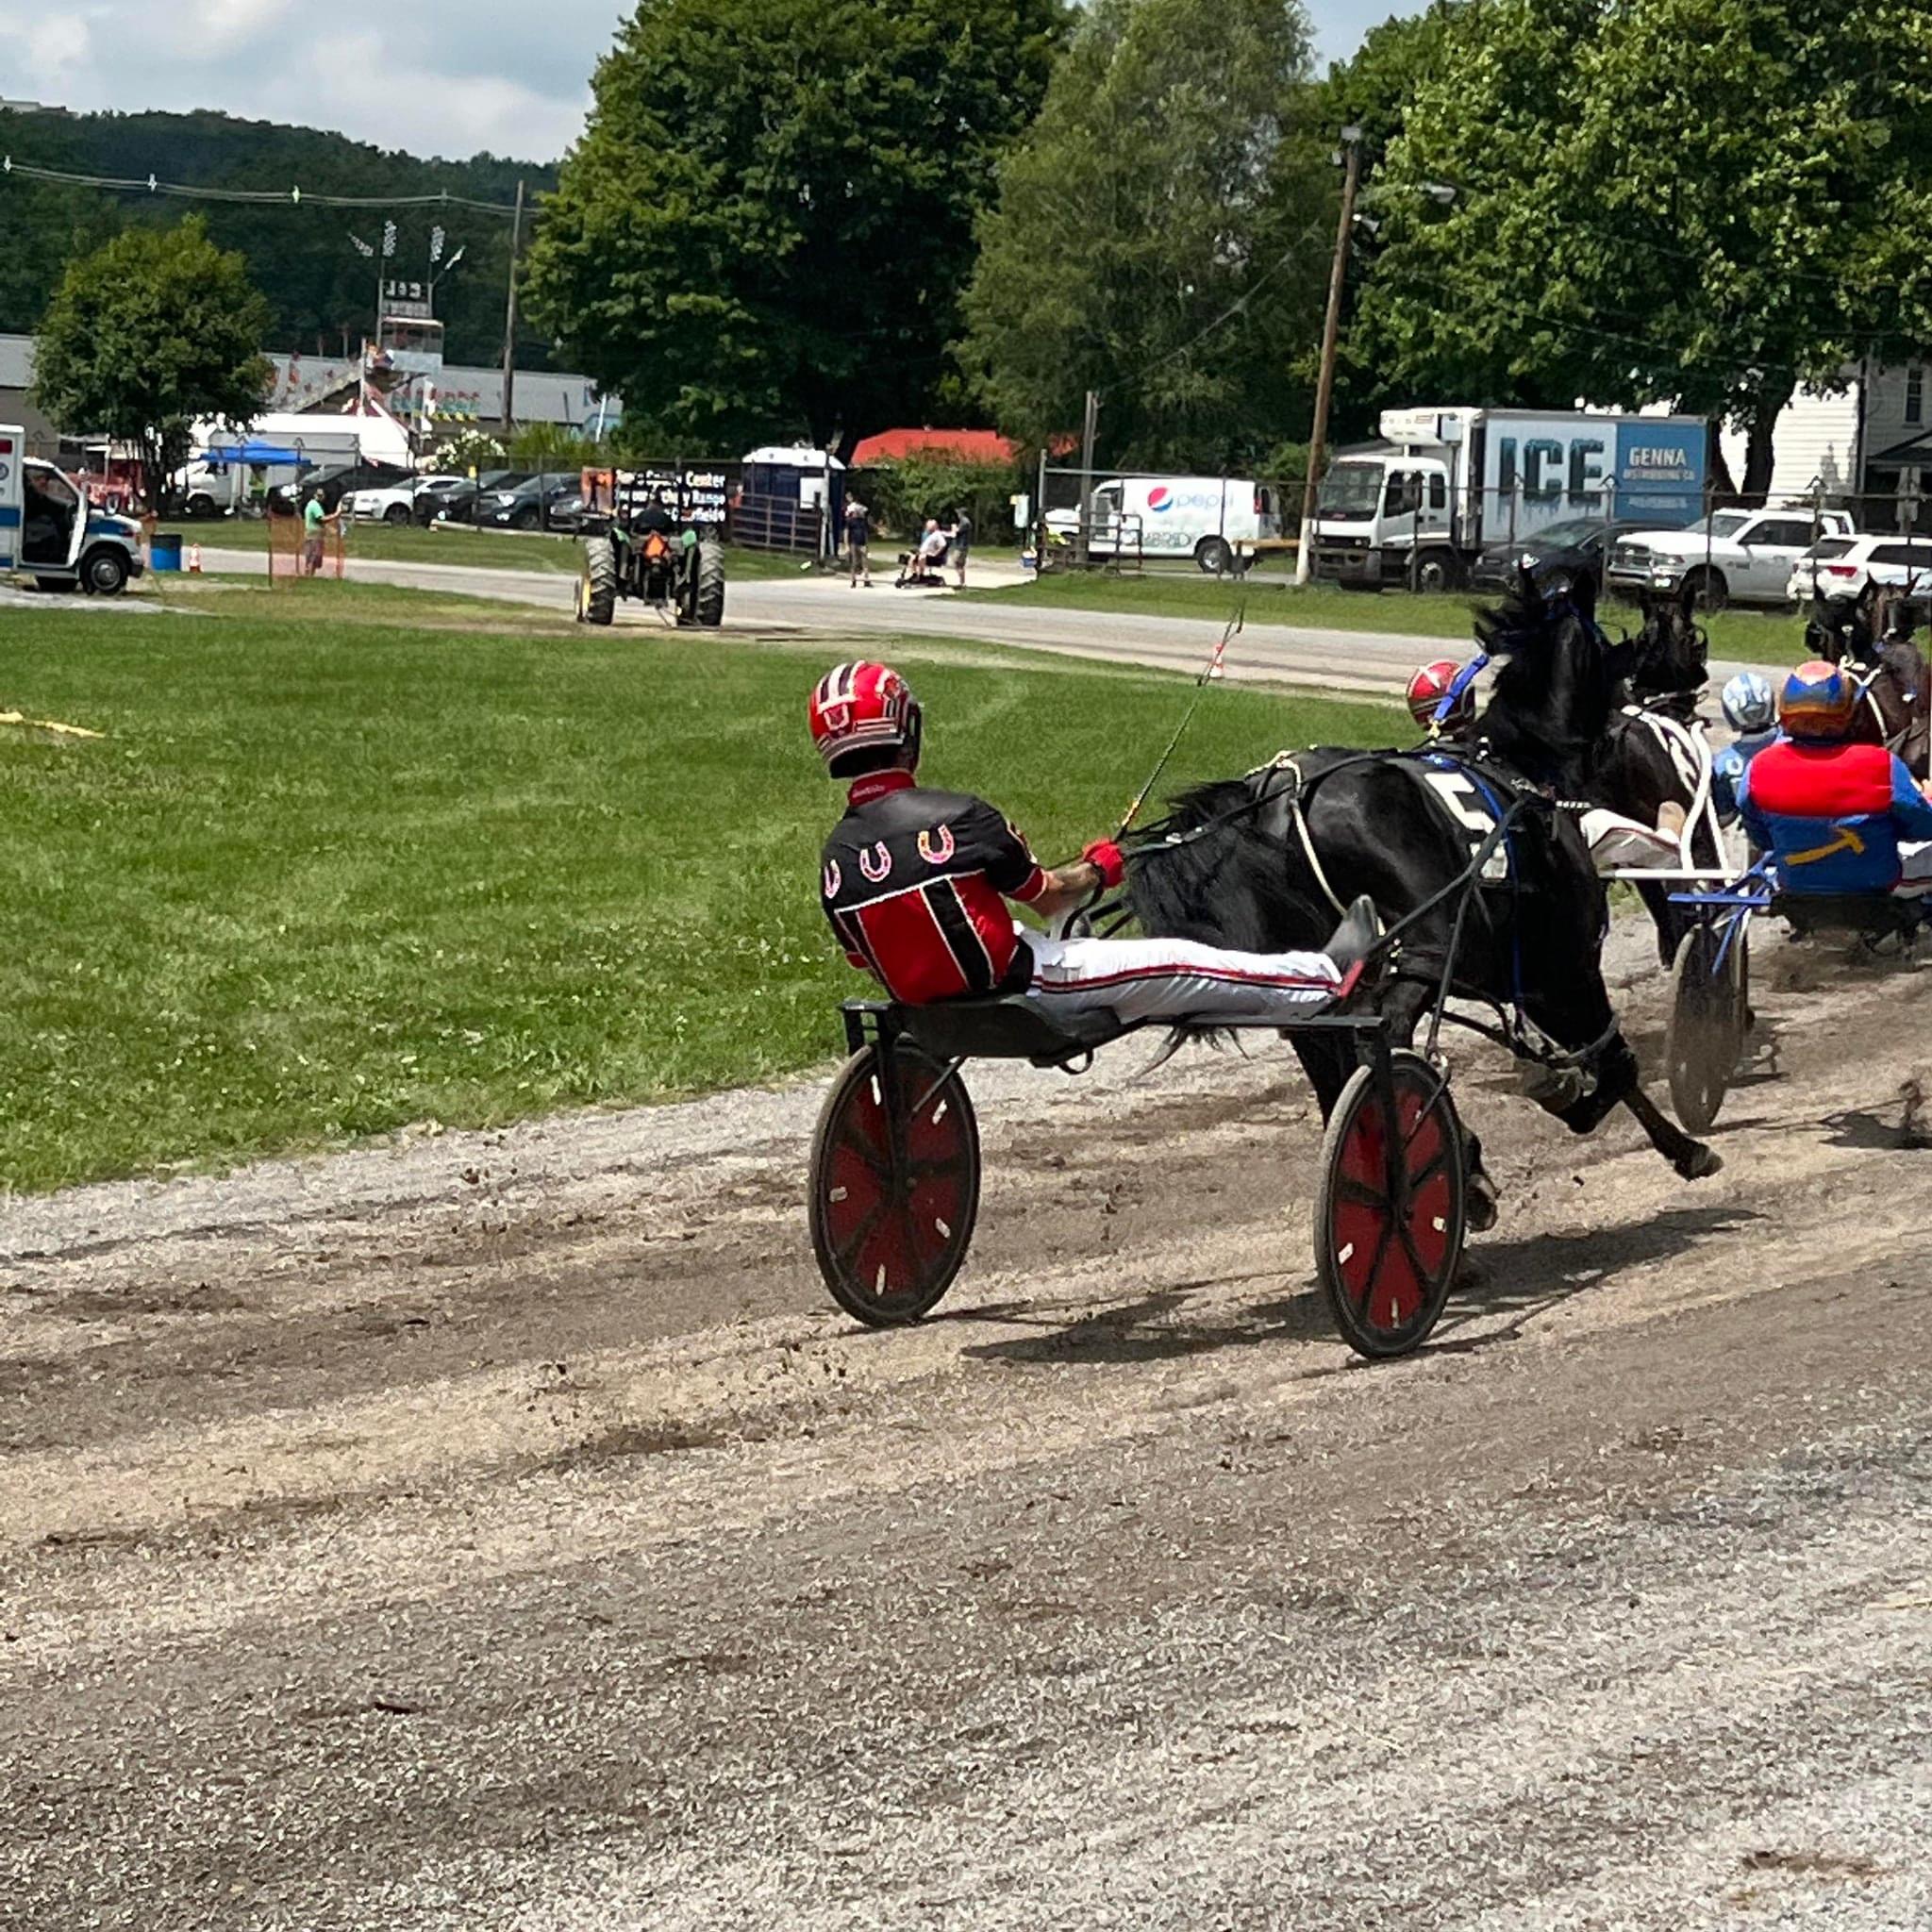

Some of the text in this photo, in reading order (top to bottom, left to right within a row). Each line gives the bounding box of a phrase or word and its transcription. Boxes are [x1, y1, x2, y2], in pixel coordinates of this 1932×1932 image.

[1629, 447, 1687, 467] GENNA
[1498, 438, 1605, 506] ICE
[1175, 491, 1235, 511] pepi
